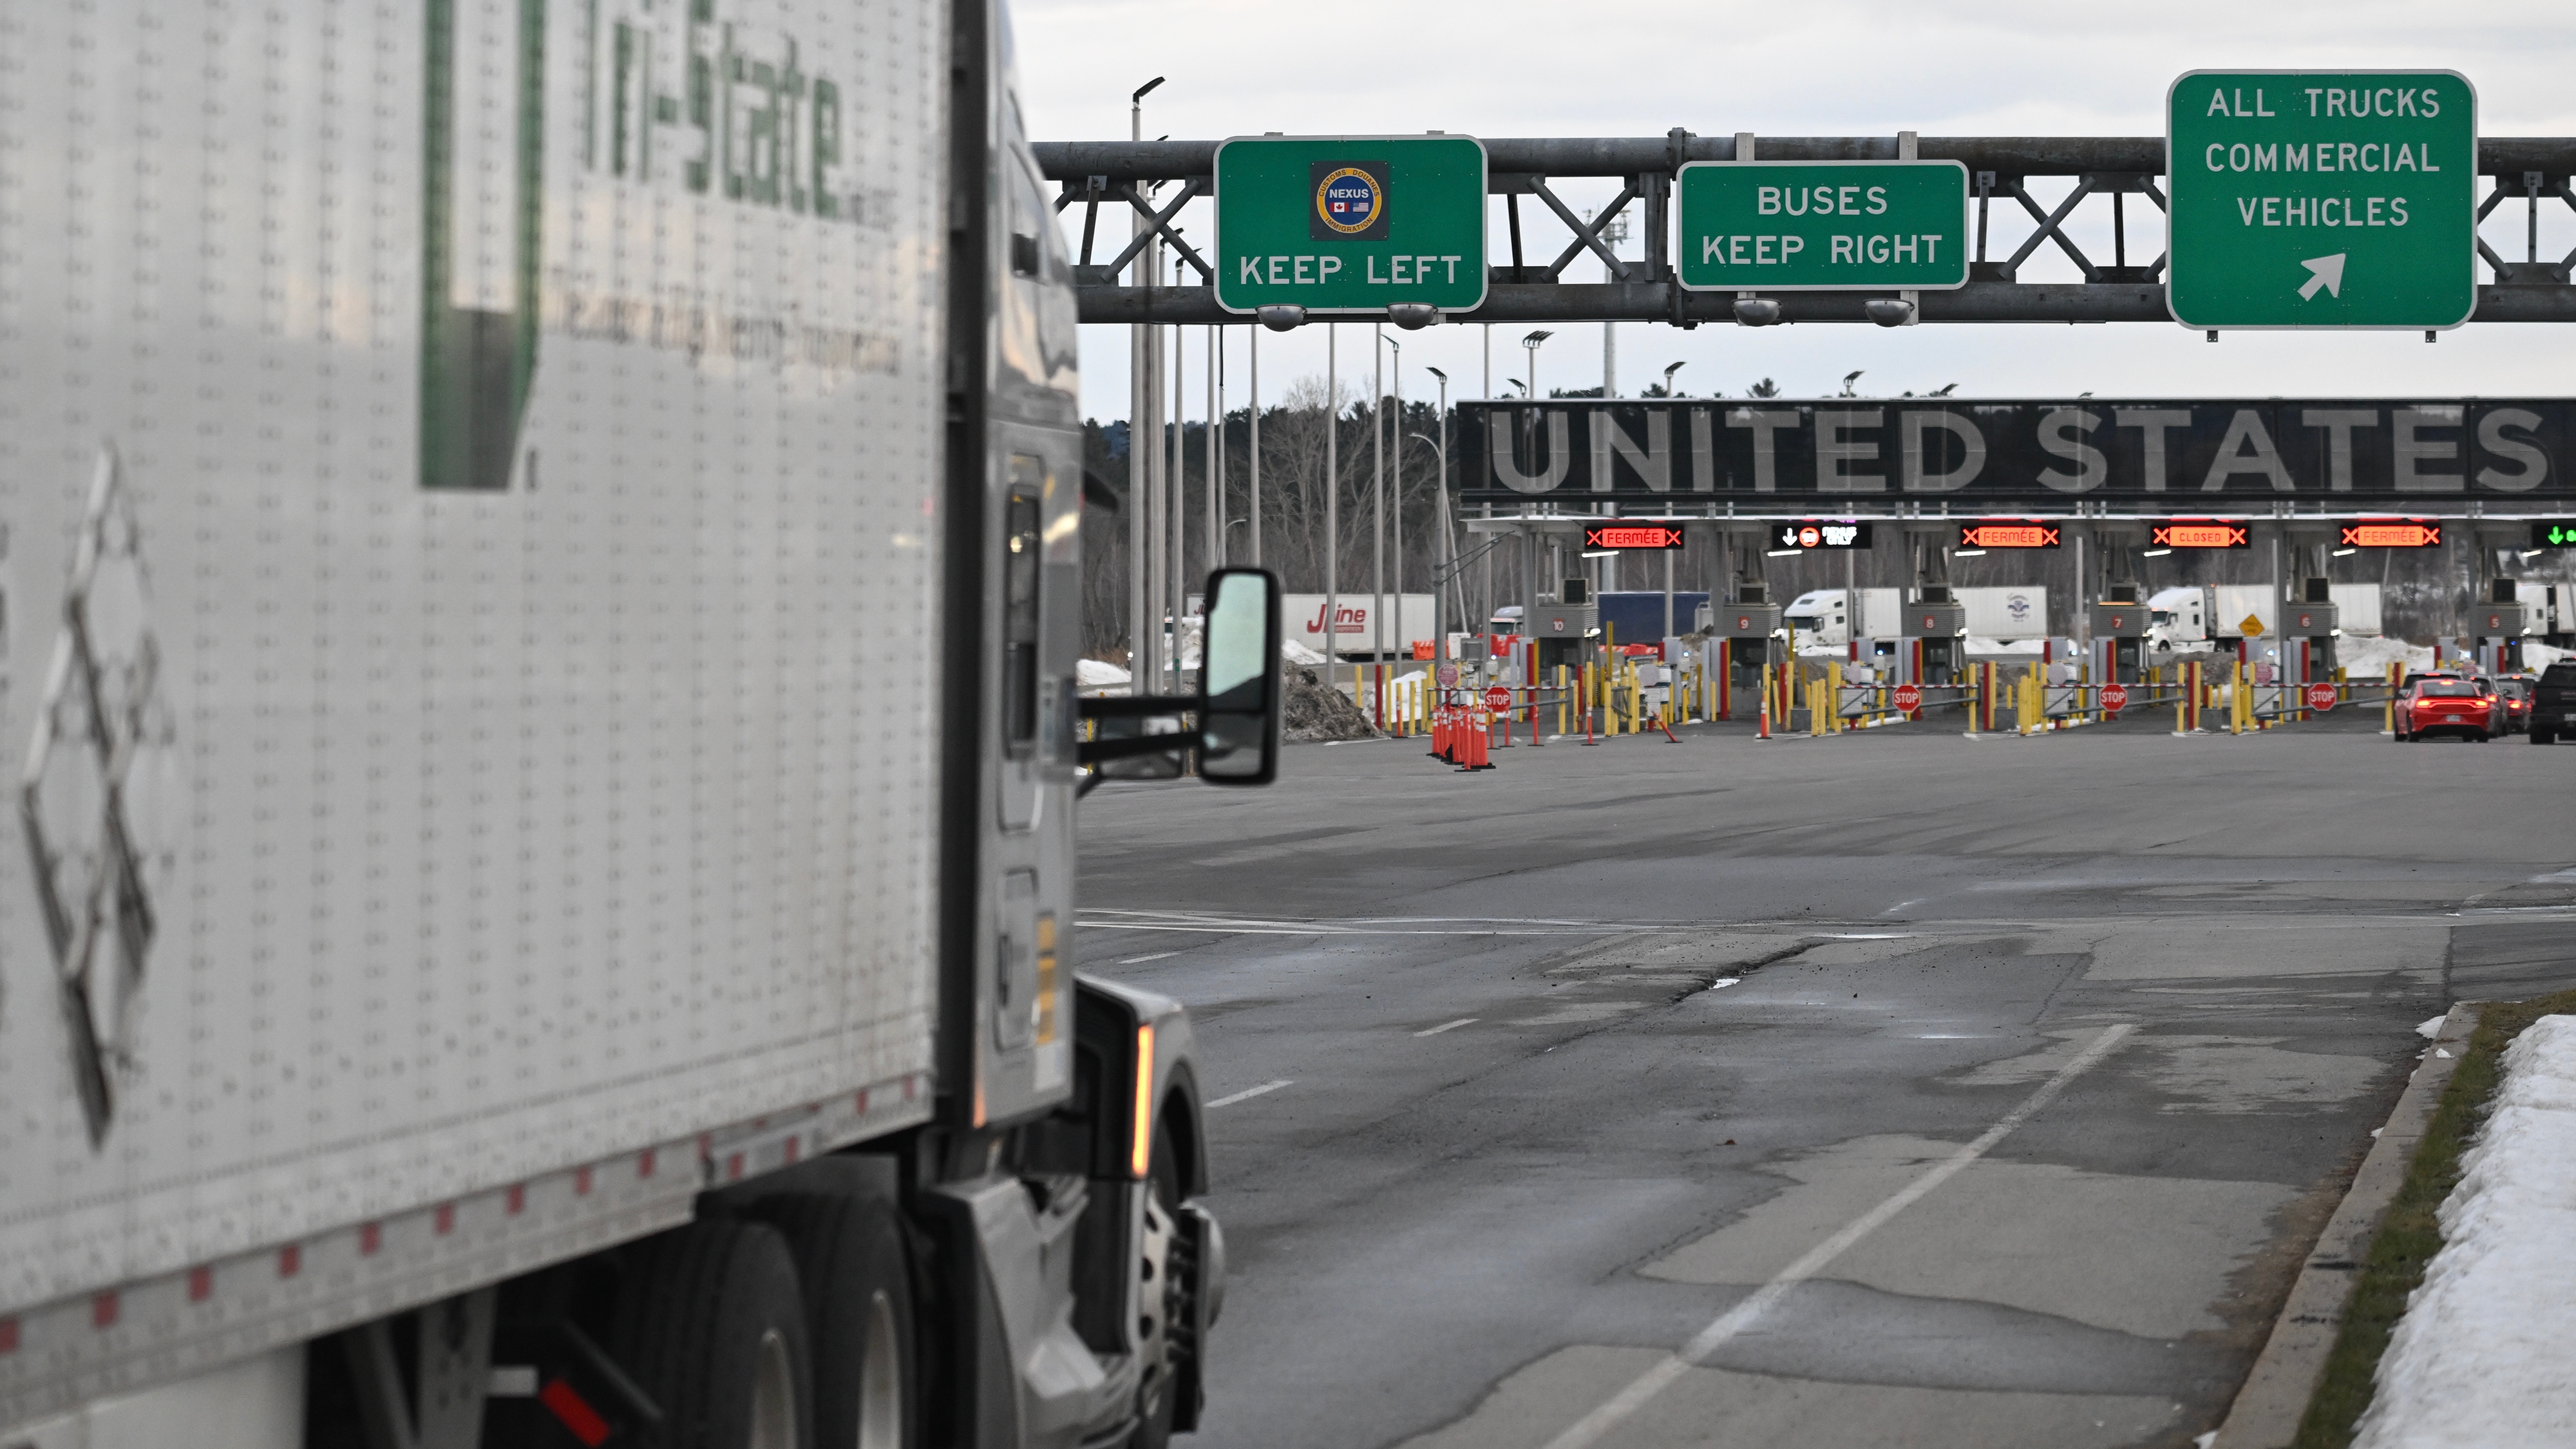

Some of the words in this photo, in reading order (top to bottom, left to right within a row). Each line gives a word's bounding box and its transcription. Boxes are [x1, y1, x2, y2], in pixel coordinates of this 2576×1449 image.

[2206, 88, 2275, 117] ALL
[2304, 88, 2440, 118] TRUCKS
[2205, 143, 2440, 173] COMMERCIAL
[1318, 169, 1347, 197] CUSTOMS
[1352, 169, 1380, 196] DOUANES
[1329, 189, 1369, 198] NEXUS
[1758, 186, 1888, 216] BUSES
[2237, 197, 2409, 227] VEHICLES
[1325, 217, 1373, 232] IMMIGRATION
[1702, 235, 1804, 265] KEEP
[1831, 234, 1942, 264] RIGHT
[1240, 256, 1342, 285] KEEP
[1367, 255, 1462, 284] LEFT
[1490, 409, 1987, 495] UNITED
[2036, 407, 2550, 495] STATES
[1607, 529, 1660, 544] FERMÉE
[1984, 529, 2036, 543] FERMÉE
[2179, 533, 2221, 542] CLOSED
[2363, 527, 2416, 542] FERMÉE
[1307, 603, 1366, 634] Jine
[1741, 620, 1748, 629] 9
[1927, 620, 1934, 629] 8
[2114, 619, 2122, 628] 7
[2302, 618, 2310, 627] 6
[2492, 618, 2499, 628] 5
[1553, 621, 1564, 632] 10
[1486, 695, 1510, 705] STOP
[1894, 693, 1918, 703] STOP
[2101, 692, 2125, 703] STOP
[2310, 692, 2334, 702] STOP
